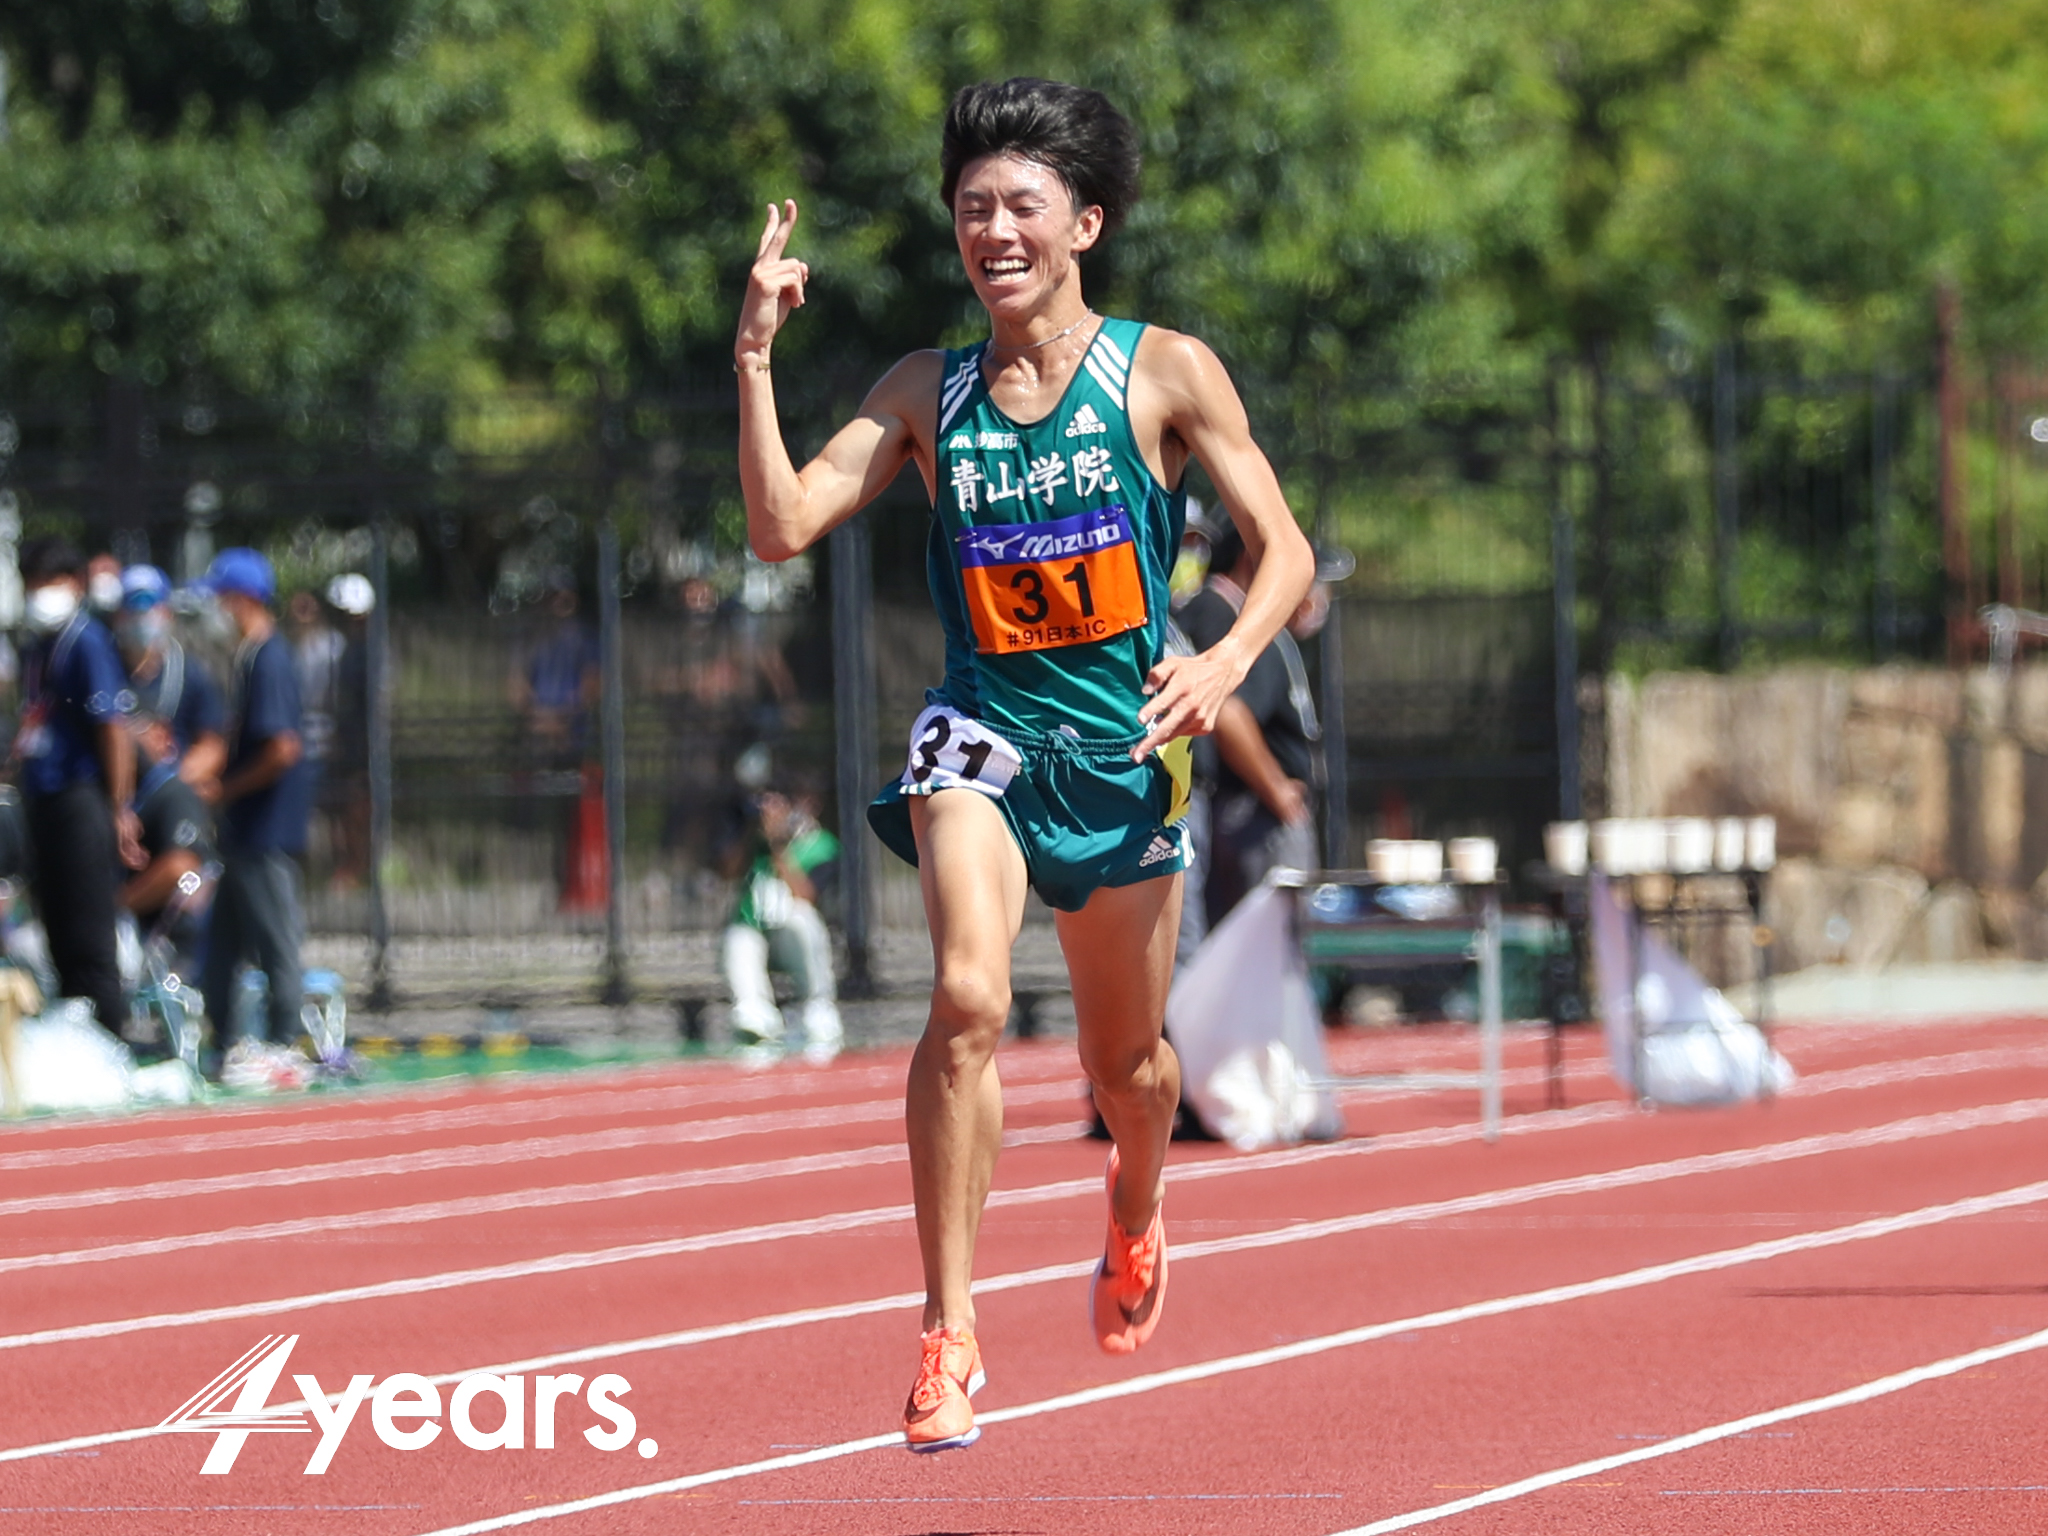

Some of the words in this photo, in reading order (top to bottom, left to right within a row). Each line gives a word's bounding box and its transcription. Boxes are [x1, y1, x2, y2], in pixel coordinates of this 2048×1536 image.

[950, 445, 1120, 512] 青山学院
[1011, 562, 1095, 624] 31
[911, 715, 993, 783] 31
[1138, 846, 1181, 868] adidas
